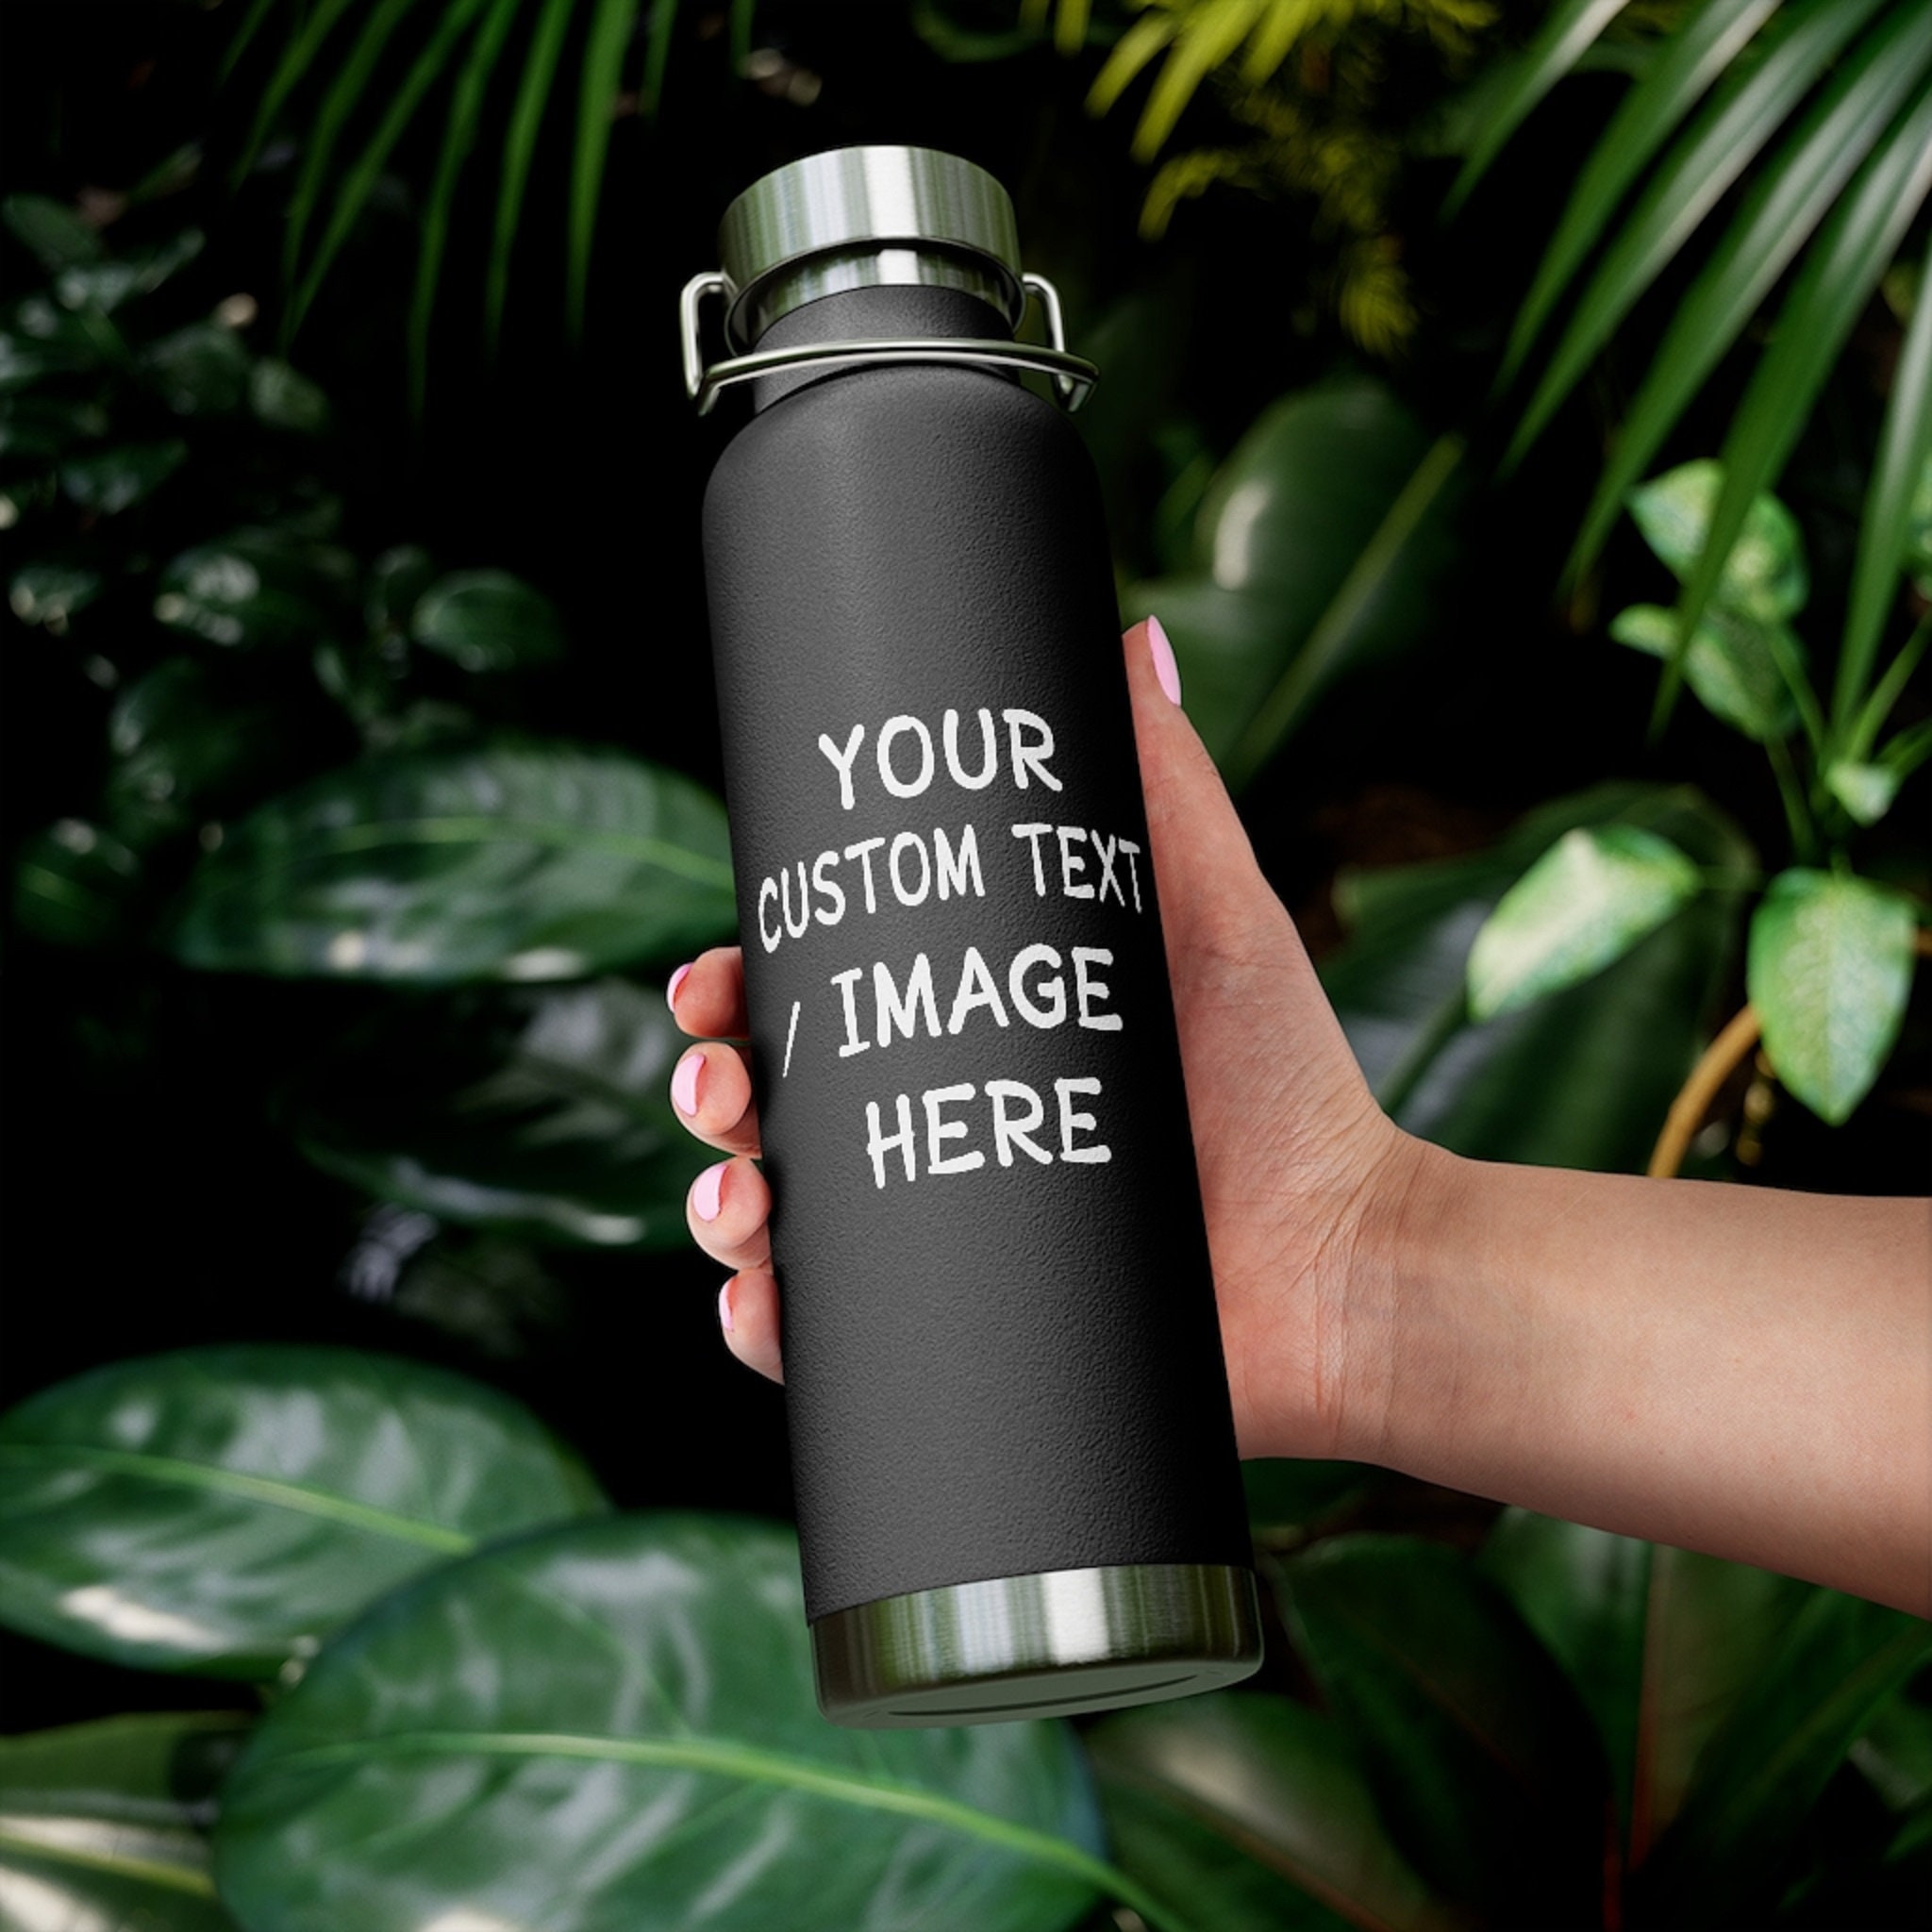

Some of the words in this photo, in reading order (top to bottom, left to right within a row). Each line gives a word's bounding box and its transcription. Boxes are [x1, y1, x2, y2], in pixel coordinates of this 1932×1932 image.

[818, 708, 1063, 810] YOUR
[758, 824, 986, 954] CUSTOM
[1010, 822, 1142, 913] TEXT
[829, 942, 1123, 1058] IMAGE
[865, 1076, 1112, 1190] HERE
